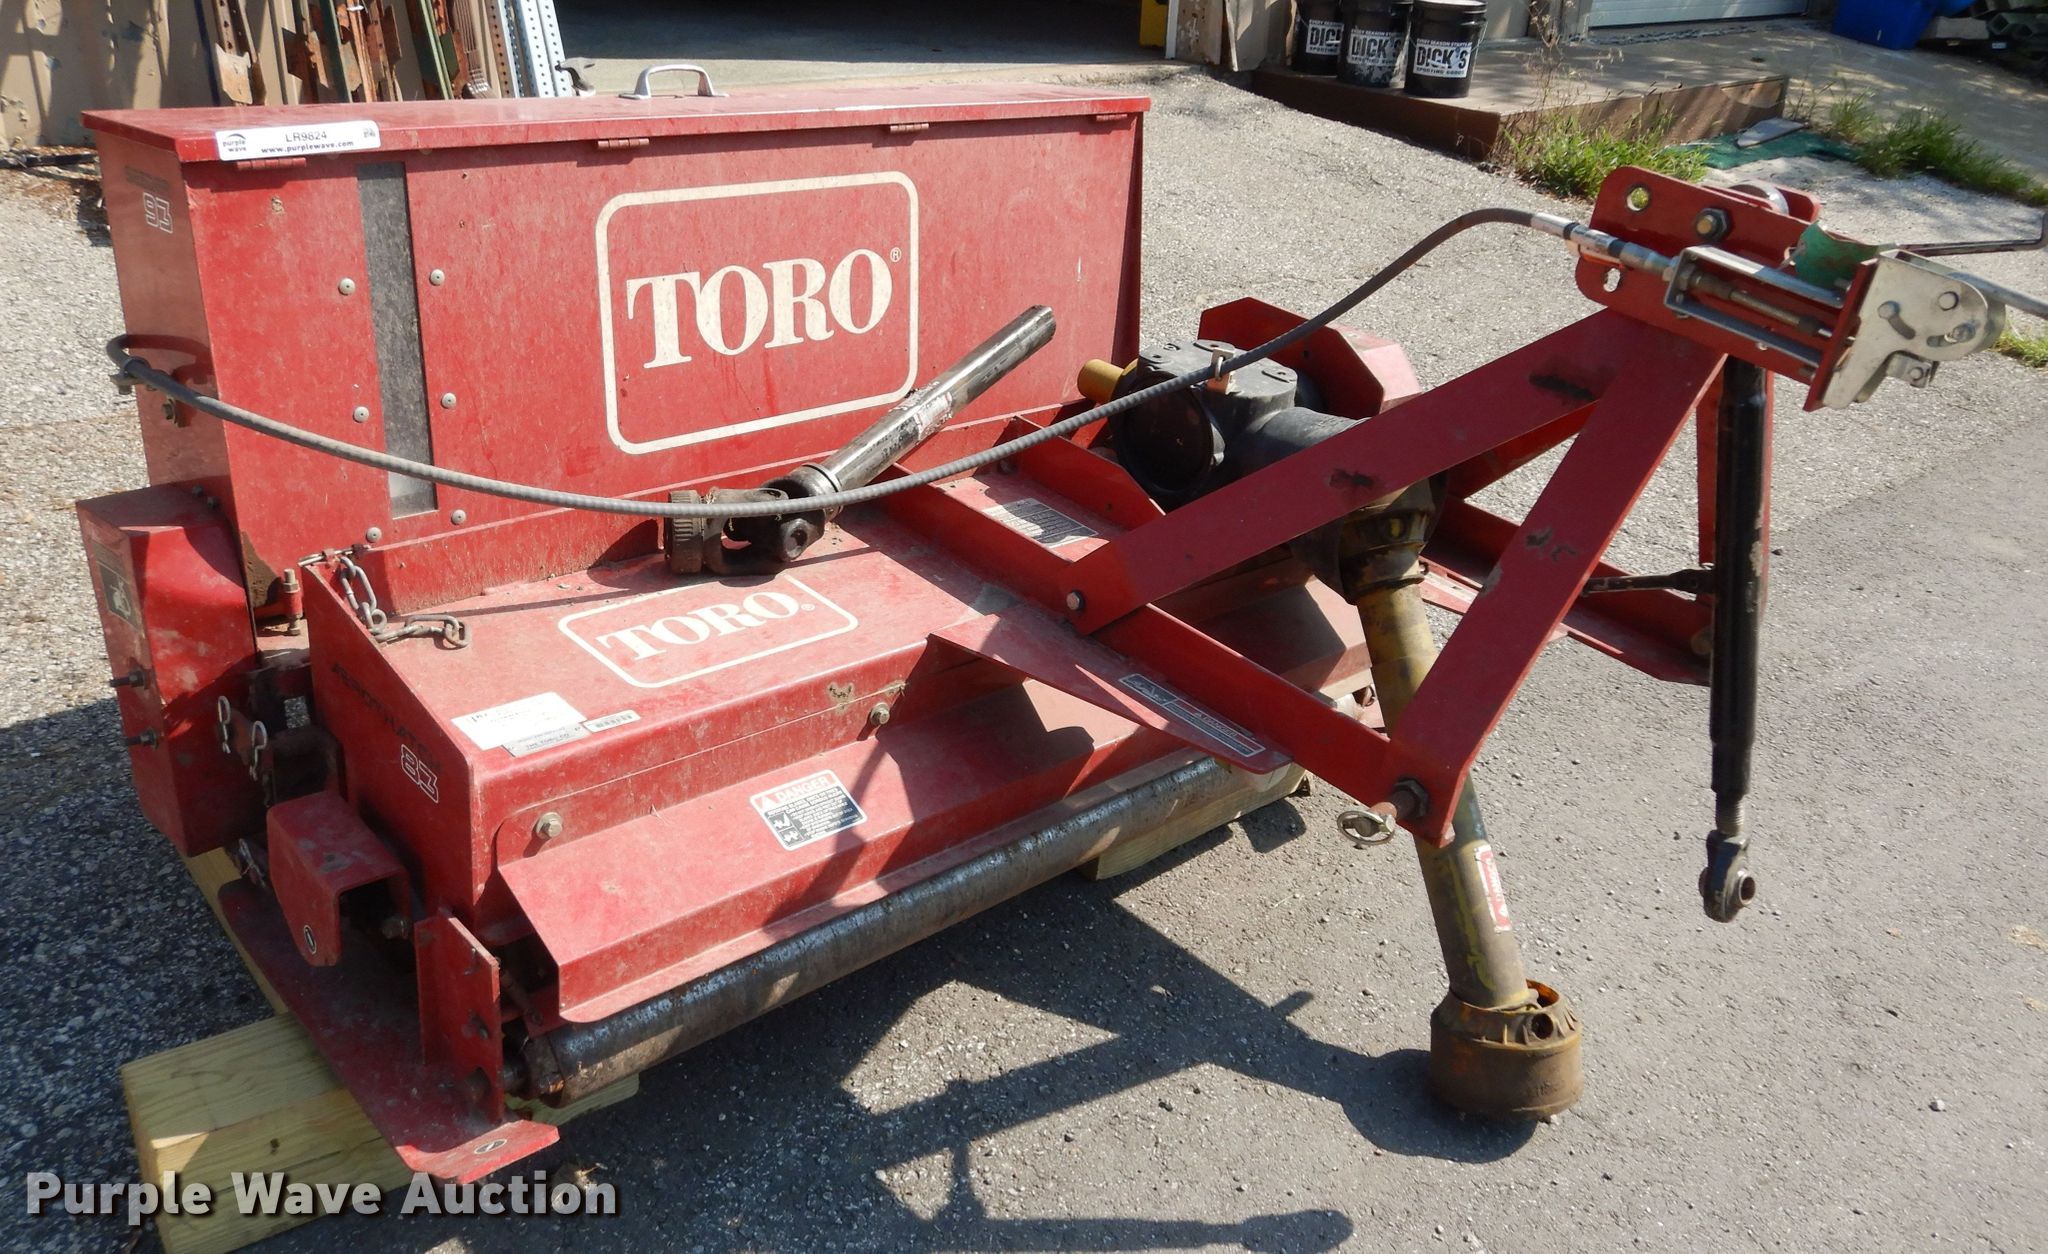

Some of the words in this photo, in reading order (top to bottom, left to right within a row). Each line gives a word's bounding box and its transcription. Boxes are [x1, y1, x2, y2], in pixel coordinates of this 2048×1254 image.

[1416, 46, 1468, 69] DICK'S
[222, 139, 246, 147] purple
[261, 140, 354, 153] www.purplewave.com
[285, 131, 327, 142] LR9824
[626, 249, 893, 369] TORO
[595, 592, 800, 661] TORO
[775, 776, 829, 801] DANGER
